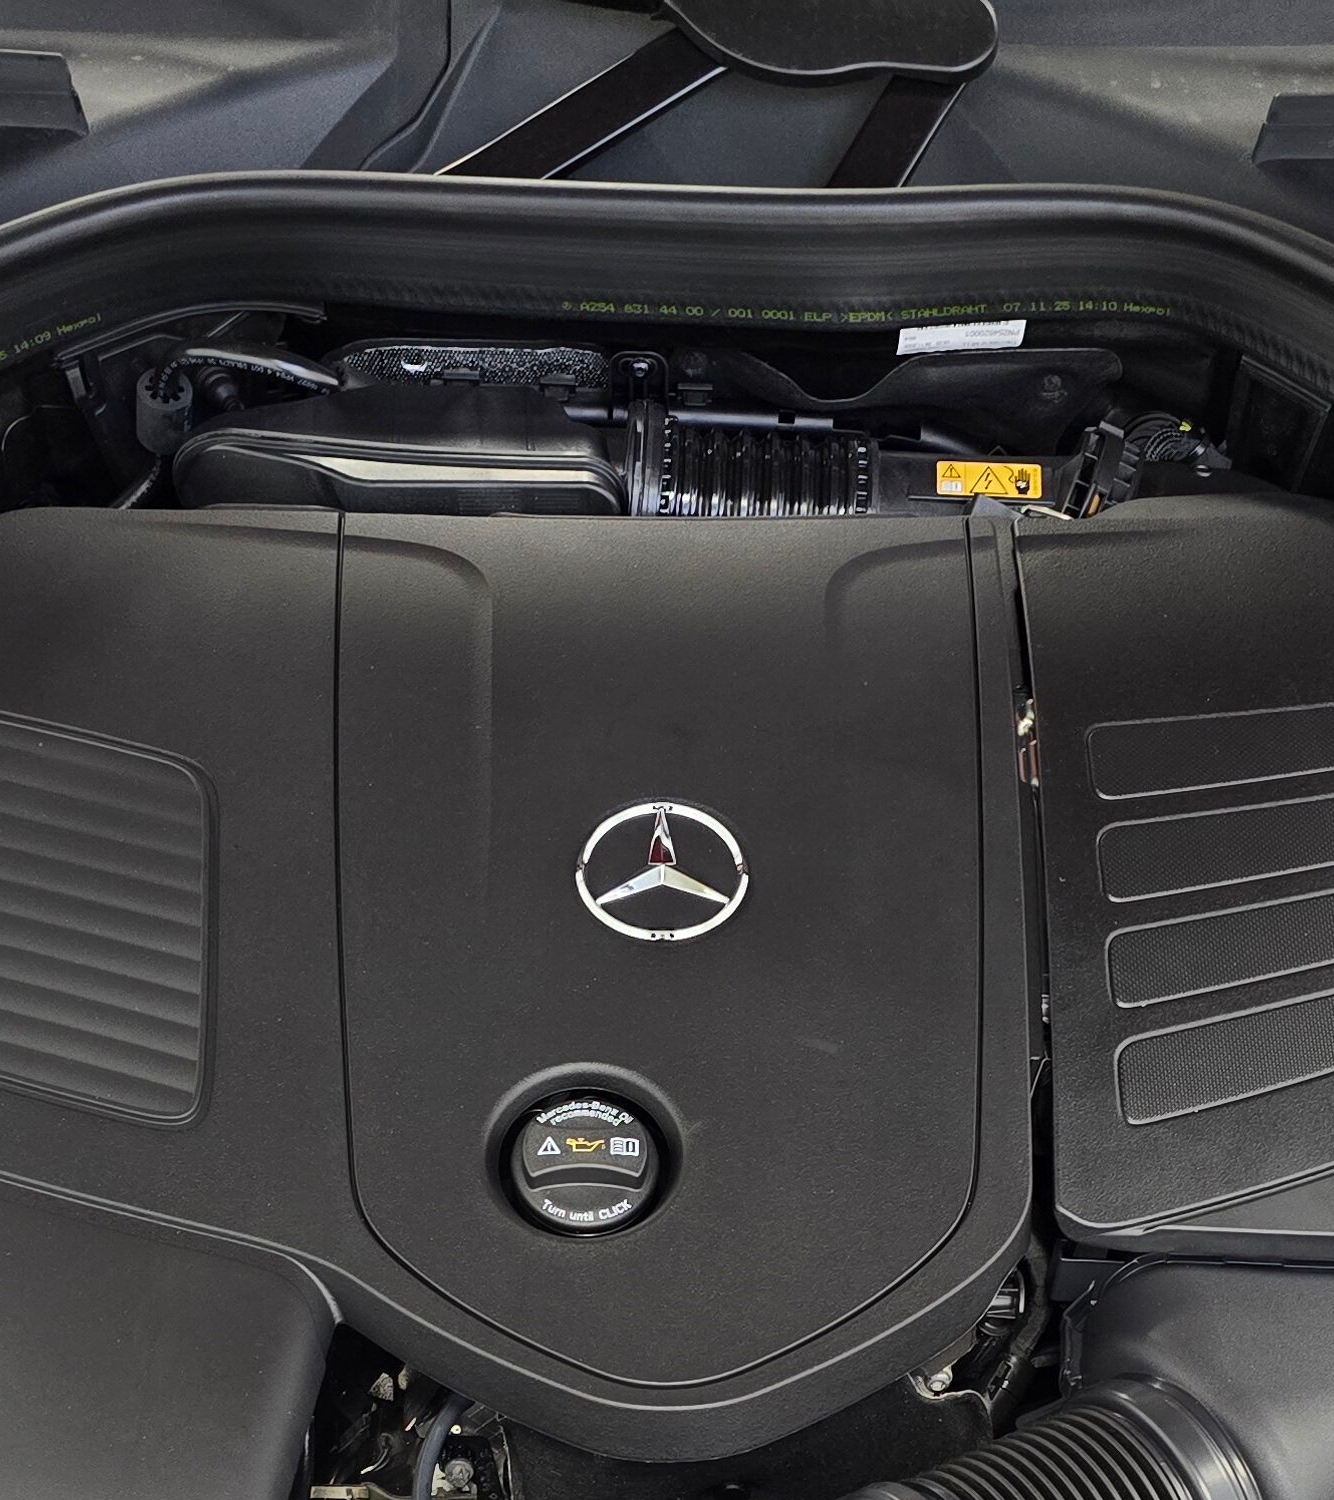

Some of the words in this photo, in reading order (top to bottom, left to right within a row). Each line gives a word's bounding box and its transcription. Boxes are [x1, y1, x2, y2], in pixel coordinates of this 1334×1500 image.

[659, 305, 677, 315] 44
[685, 306, 704, 316] 00
[728, 308, 753, 319] 001
[762, 309, 795, 320] 0001
[536, 1100, 619, 1124] Mercedes-Benz
[550, 1109, 622, 1126] recommended
[541, 1199, 566, 1218] Turn
[569, 1210, 594, 1222] until
[598, 1199, 633, 1220] CLICK
